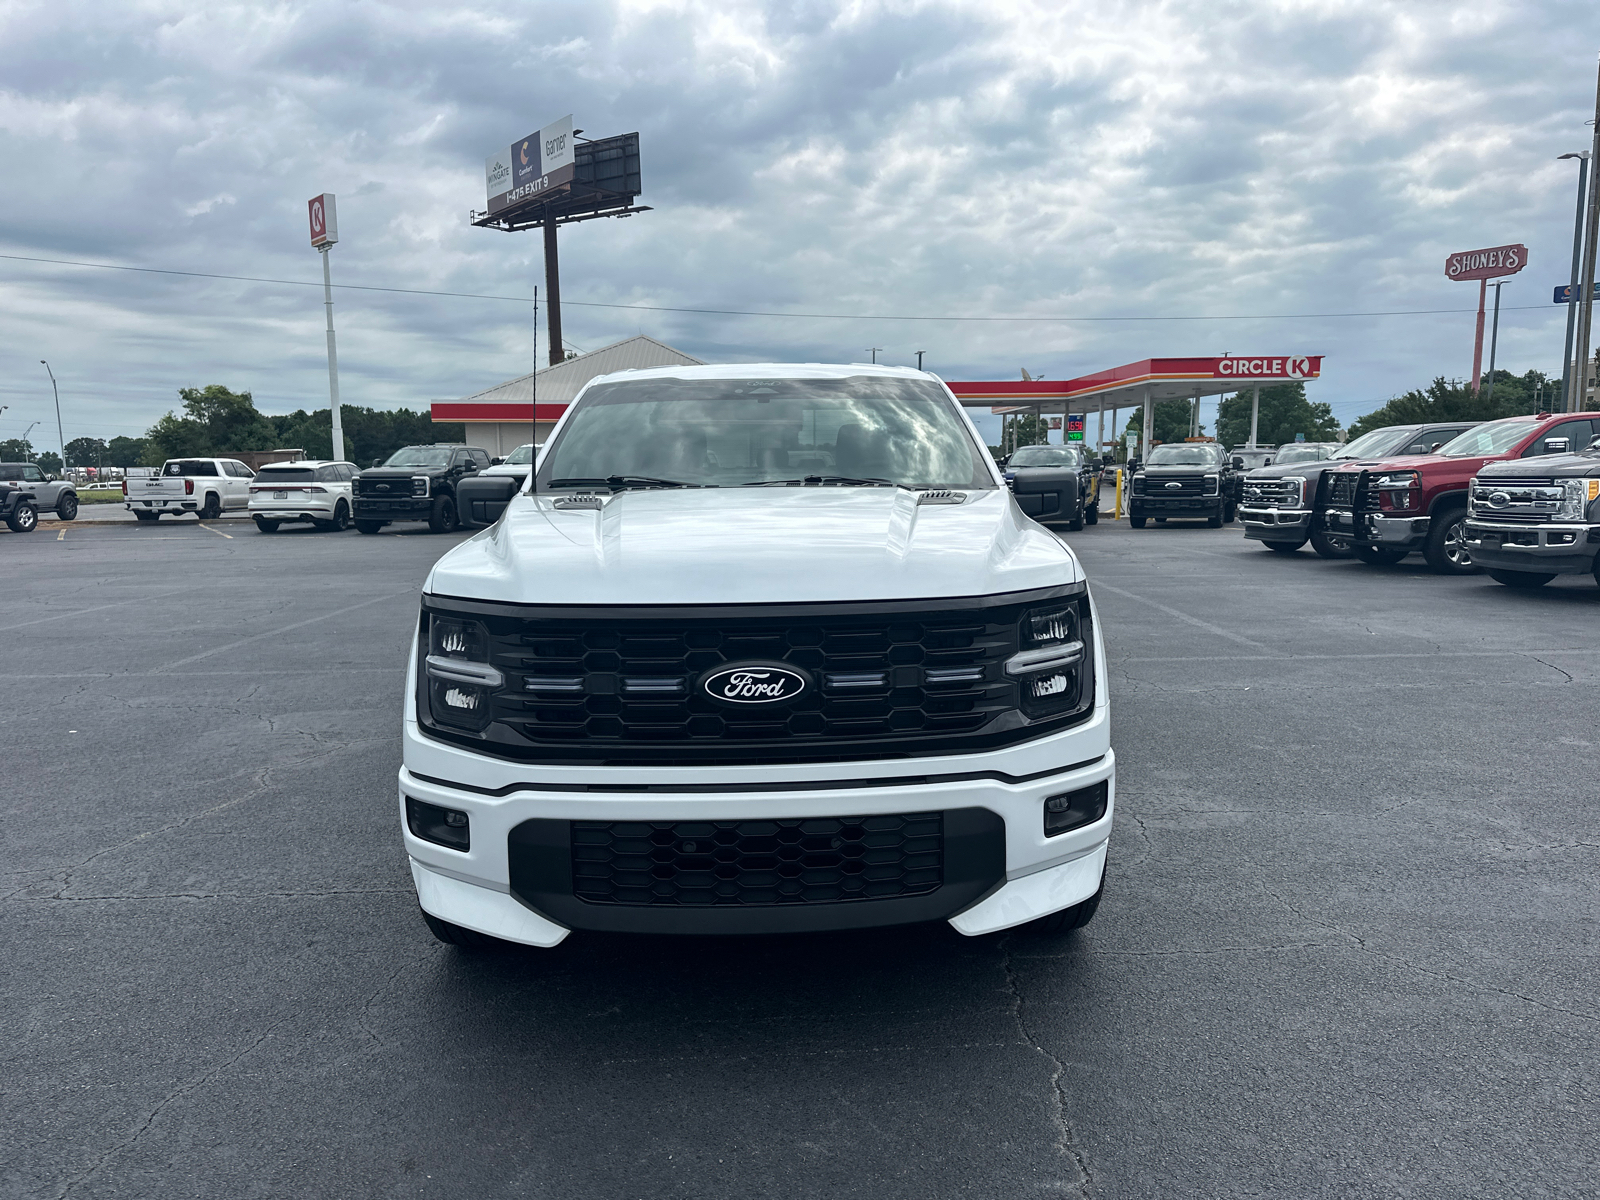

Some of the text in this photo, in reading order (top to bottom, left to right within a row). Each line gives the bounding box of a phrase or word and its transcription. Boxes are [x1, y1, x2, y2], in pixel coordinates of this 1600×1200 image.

[546, 134, 567, 157] Garner
[487, 166, 510, 184] WINGATE
[506, 187, 525, 204] I-475
[525, 178, 543, 195] EXIT
[543, 175, 549, 188] 9
[312, 204, 322, 231] K
[1449, 248, 1519, 276] SHONEY'S
[1218, 358, 1307, 378] CIRCLE K
[724, 672, 786, 697] Ford
